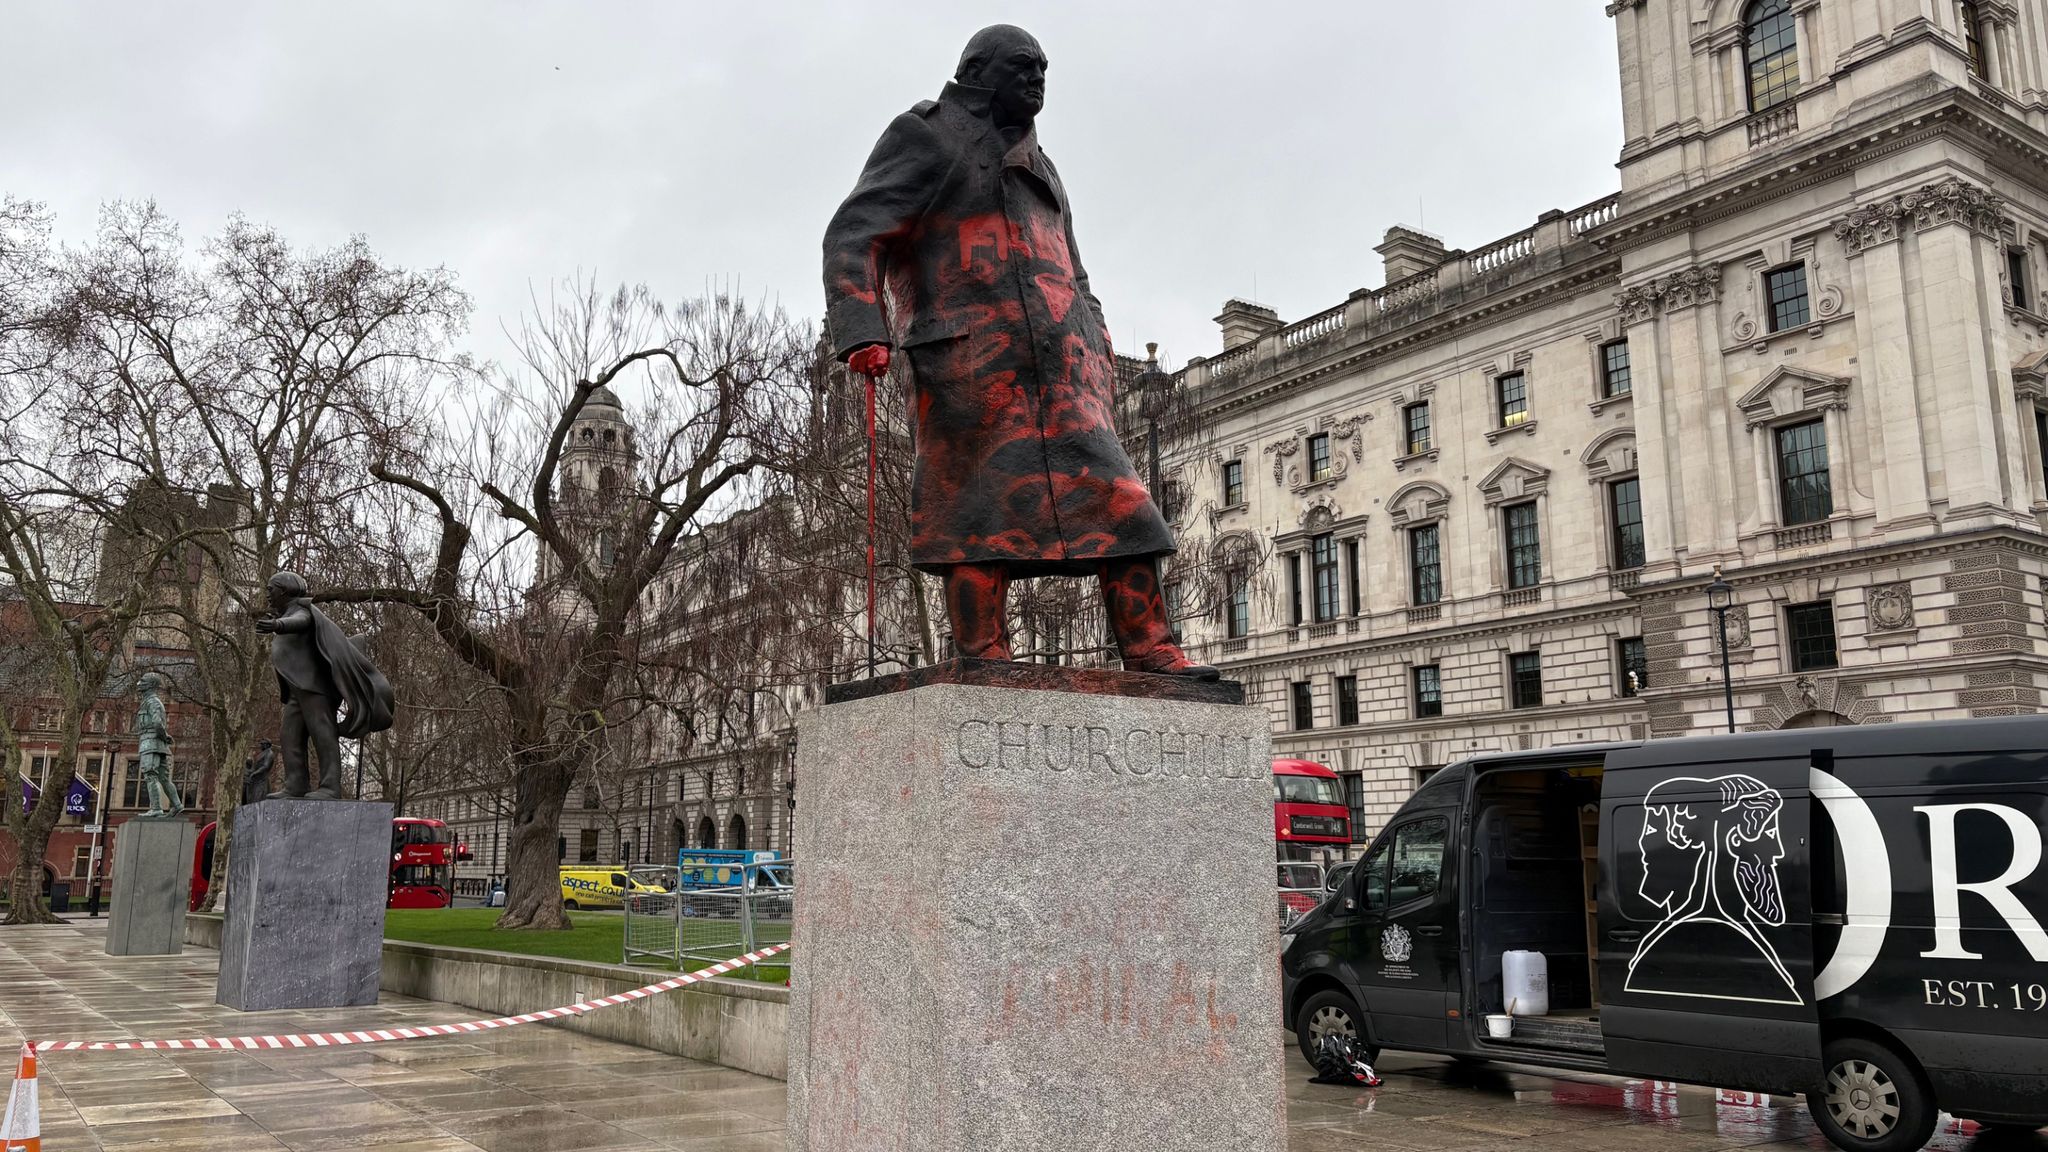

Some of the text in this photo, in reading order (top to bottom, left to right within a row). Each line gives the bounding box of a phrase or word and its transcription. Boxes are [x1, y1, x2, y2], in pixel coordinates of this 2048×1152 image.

[956, 718, 1266, 780] CHURCHILL
[1921, 979, 2047, 1012] EST. 19
